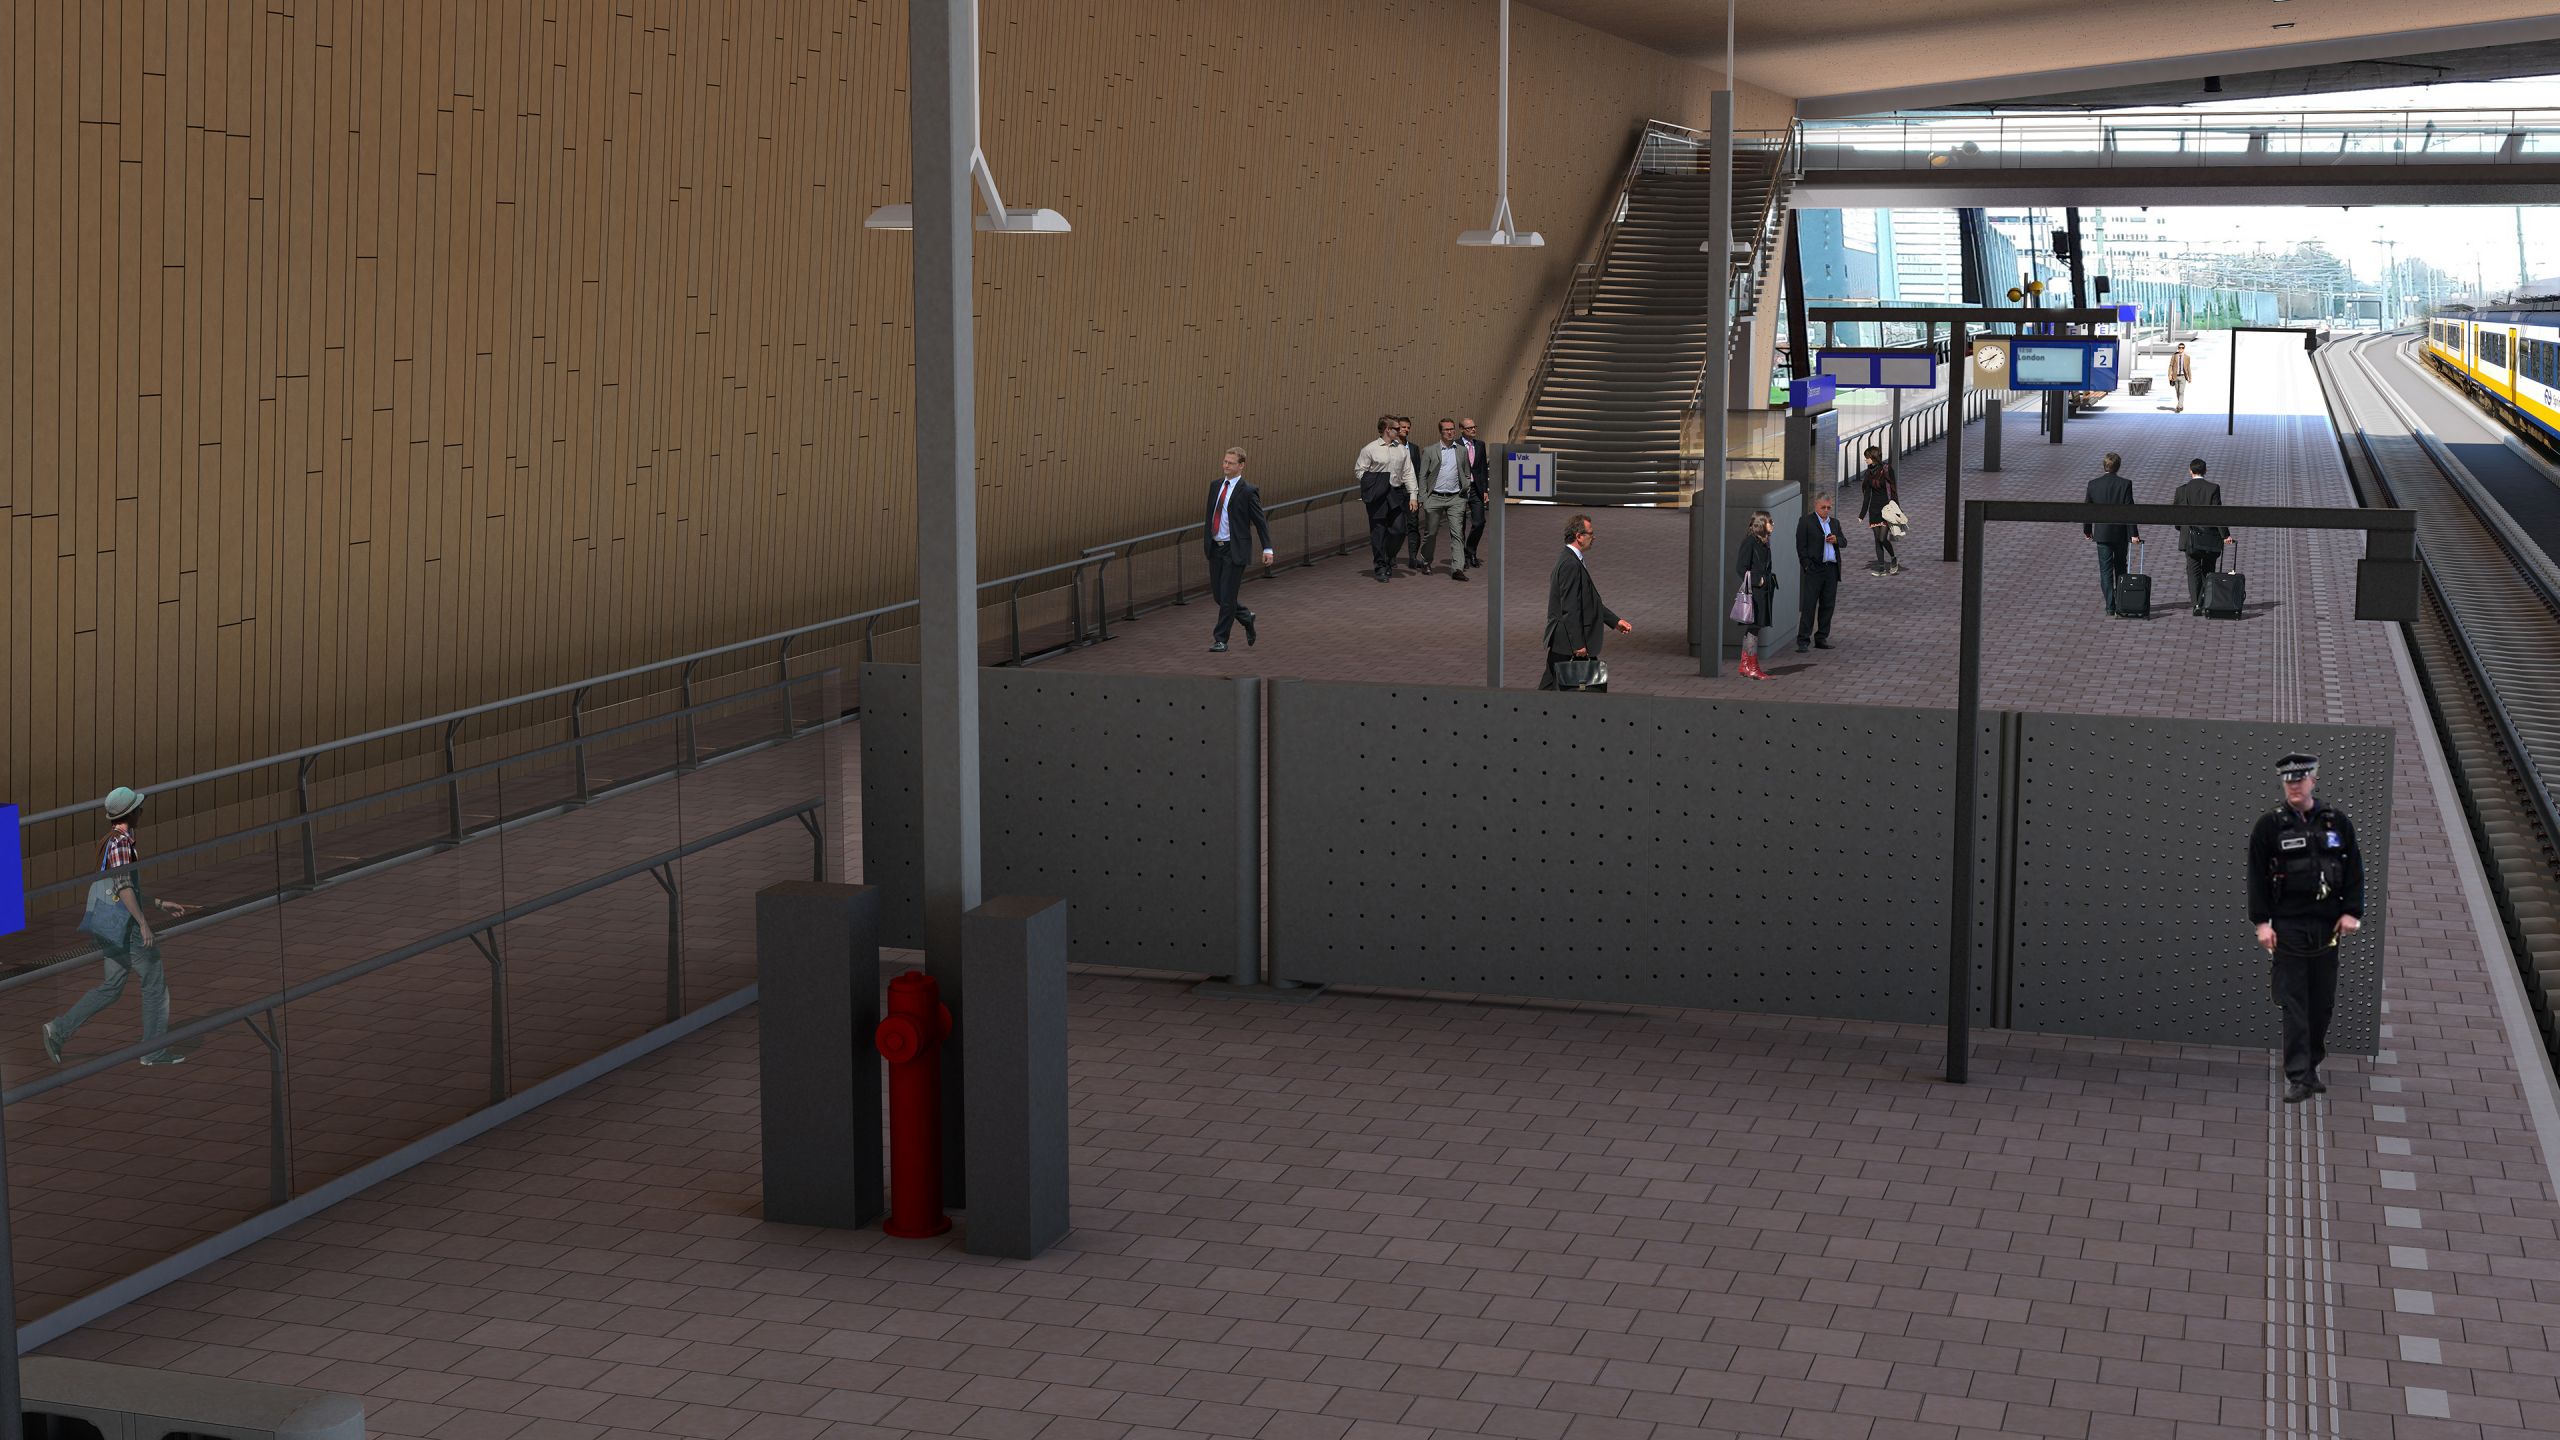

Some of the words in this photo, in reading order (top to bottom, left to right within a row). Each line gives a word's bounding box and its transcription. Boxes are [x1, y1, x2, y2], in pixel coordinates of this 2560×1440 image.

[2017, 353, 2045, 361] London
[2100, 355, 2106, 366] 2
[1518, 463, 1541, 492] H
